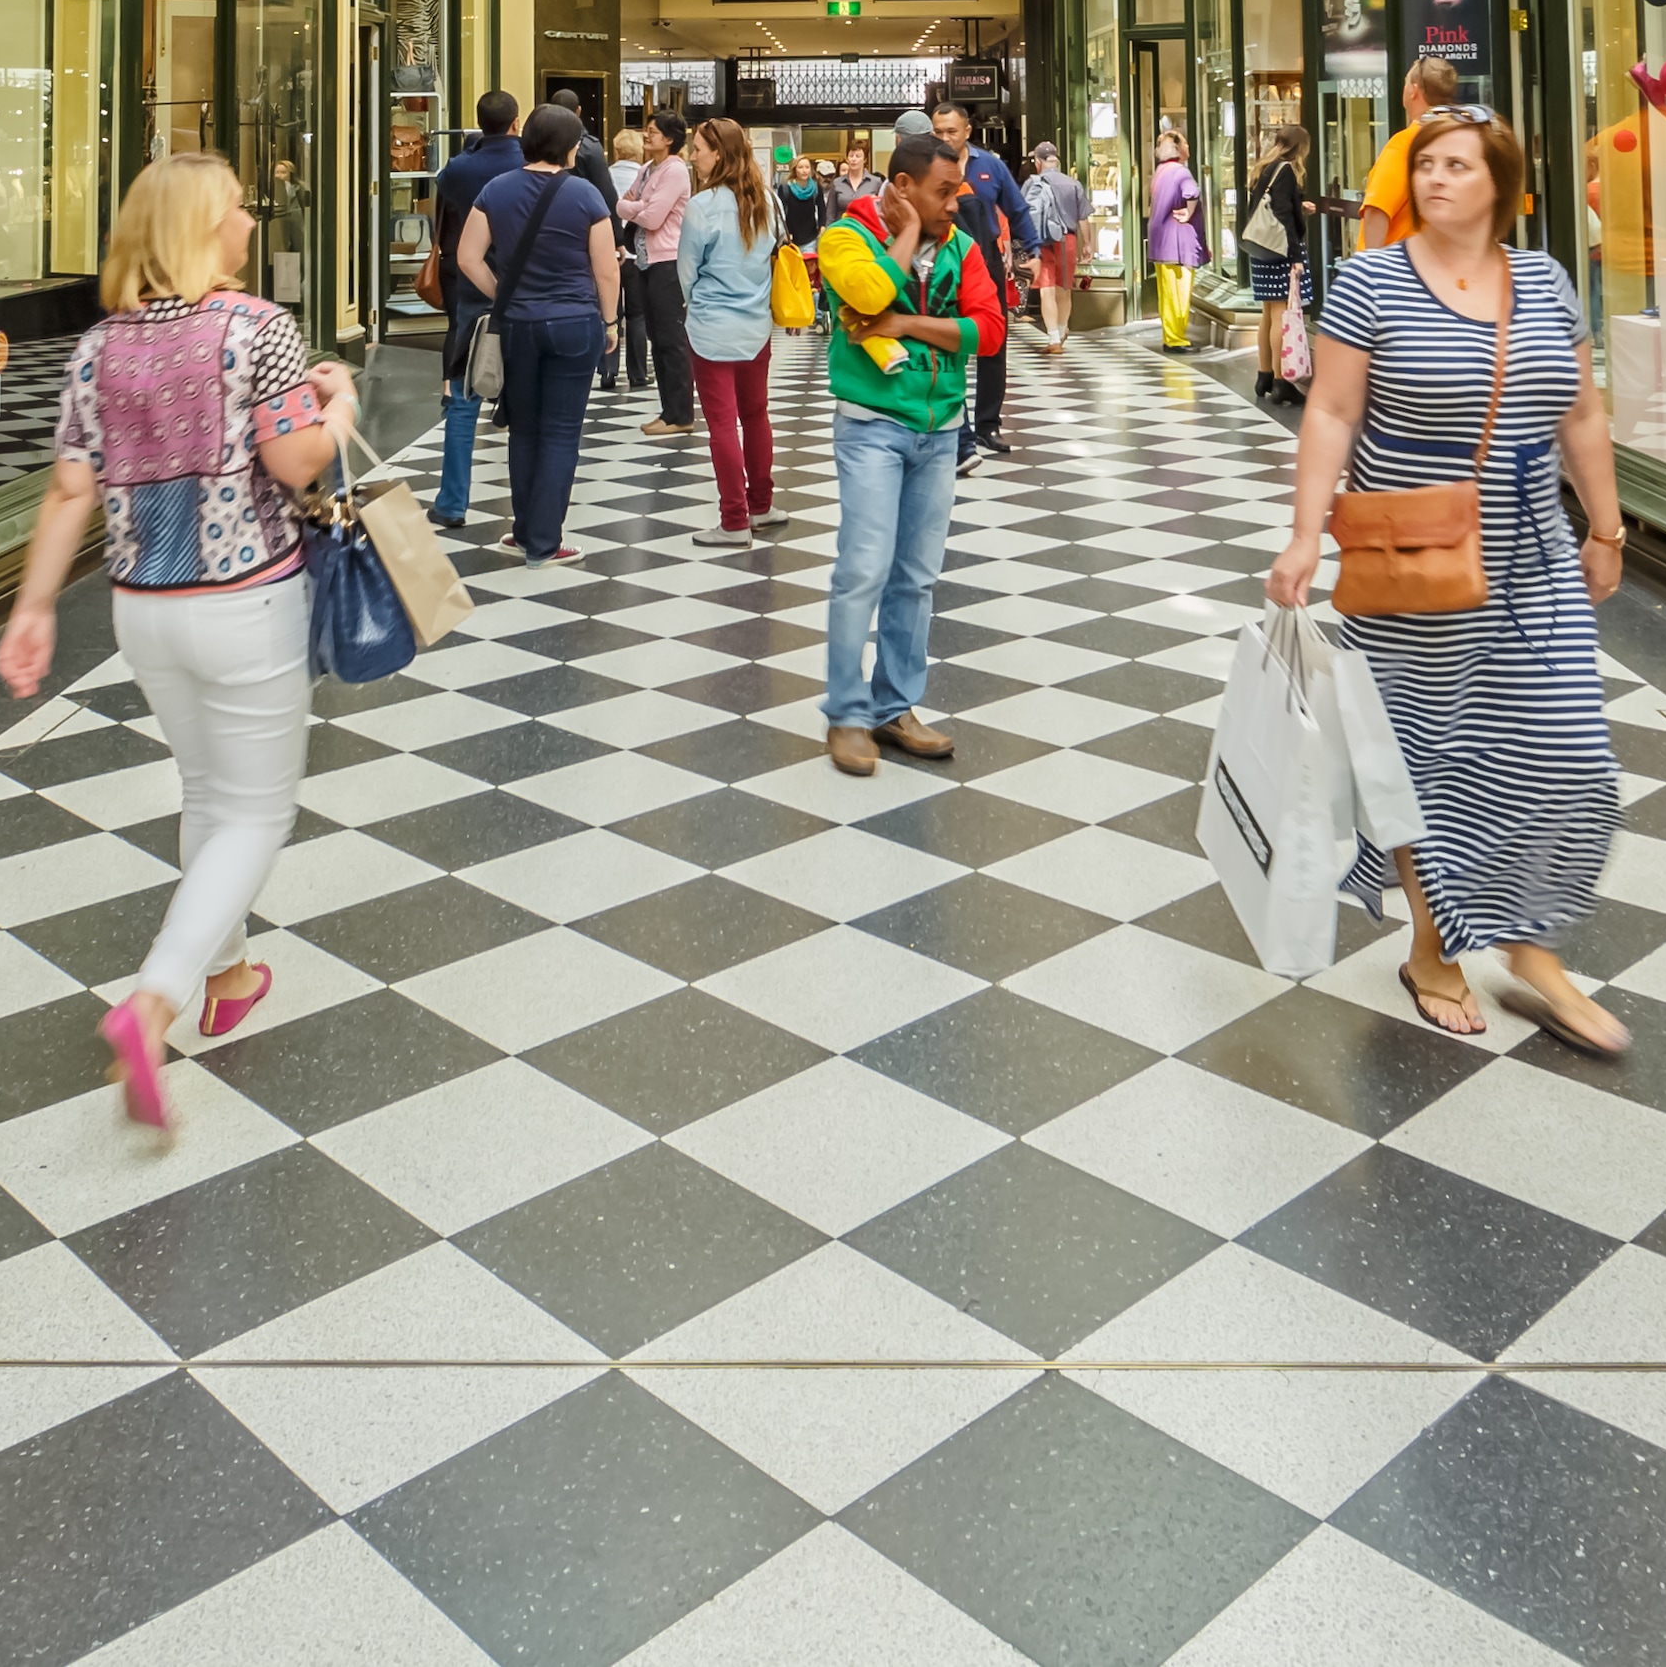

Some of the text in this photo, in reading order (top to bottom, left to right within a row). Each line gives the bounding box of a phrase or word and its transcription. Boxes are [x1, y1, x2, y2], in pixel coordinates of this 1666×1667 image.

[1425, 24, 1469, 43] Pink
[1418, 43, 1478, 53] DIAMONDS
[1444, 52, 1478, 60] ARGYLE
